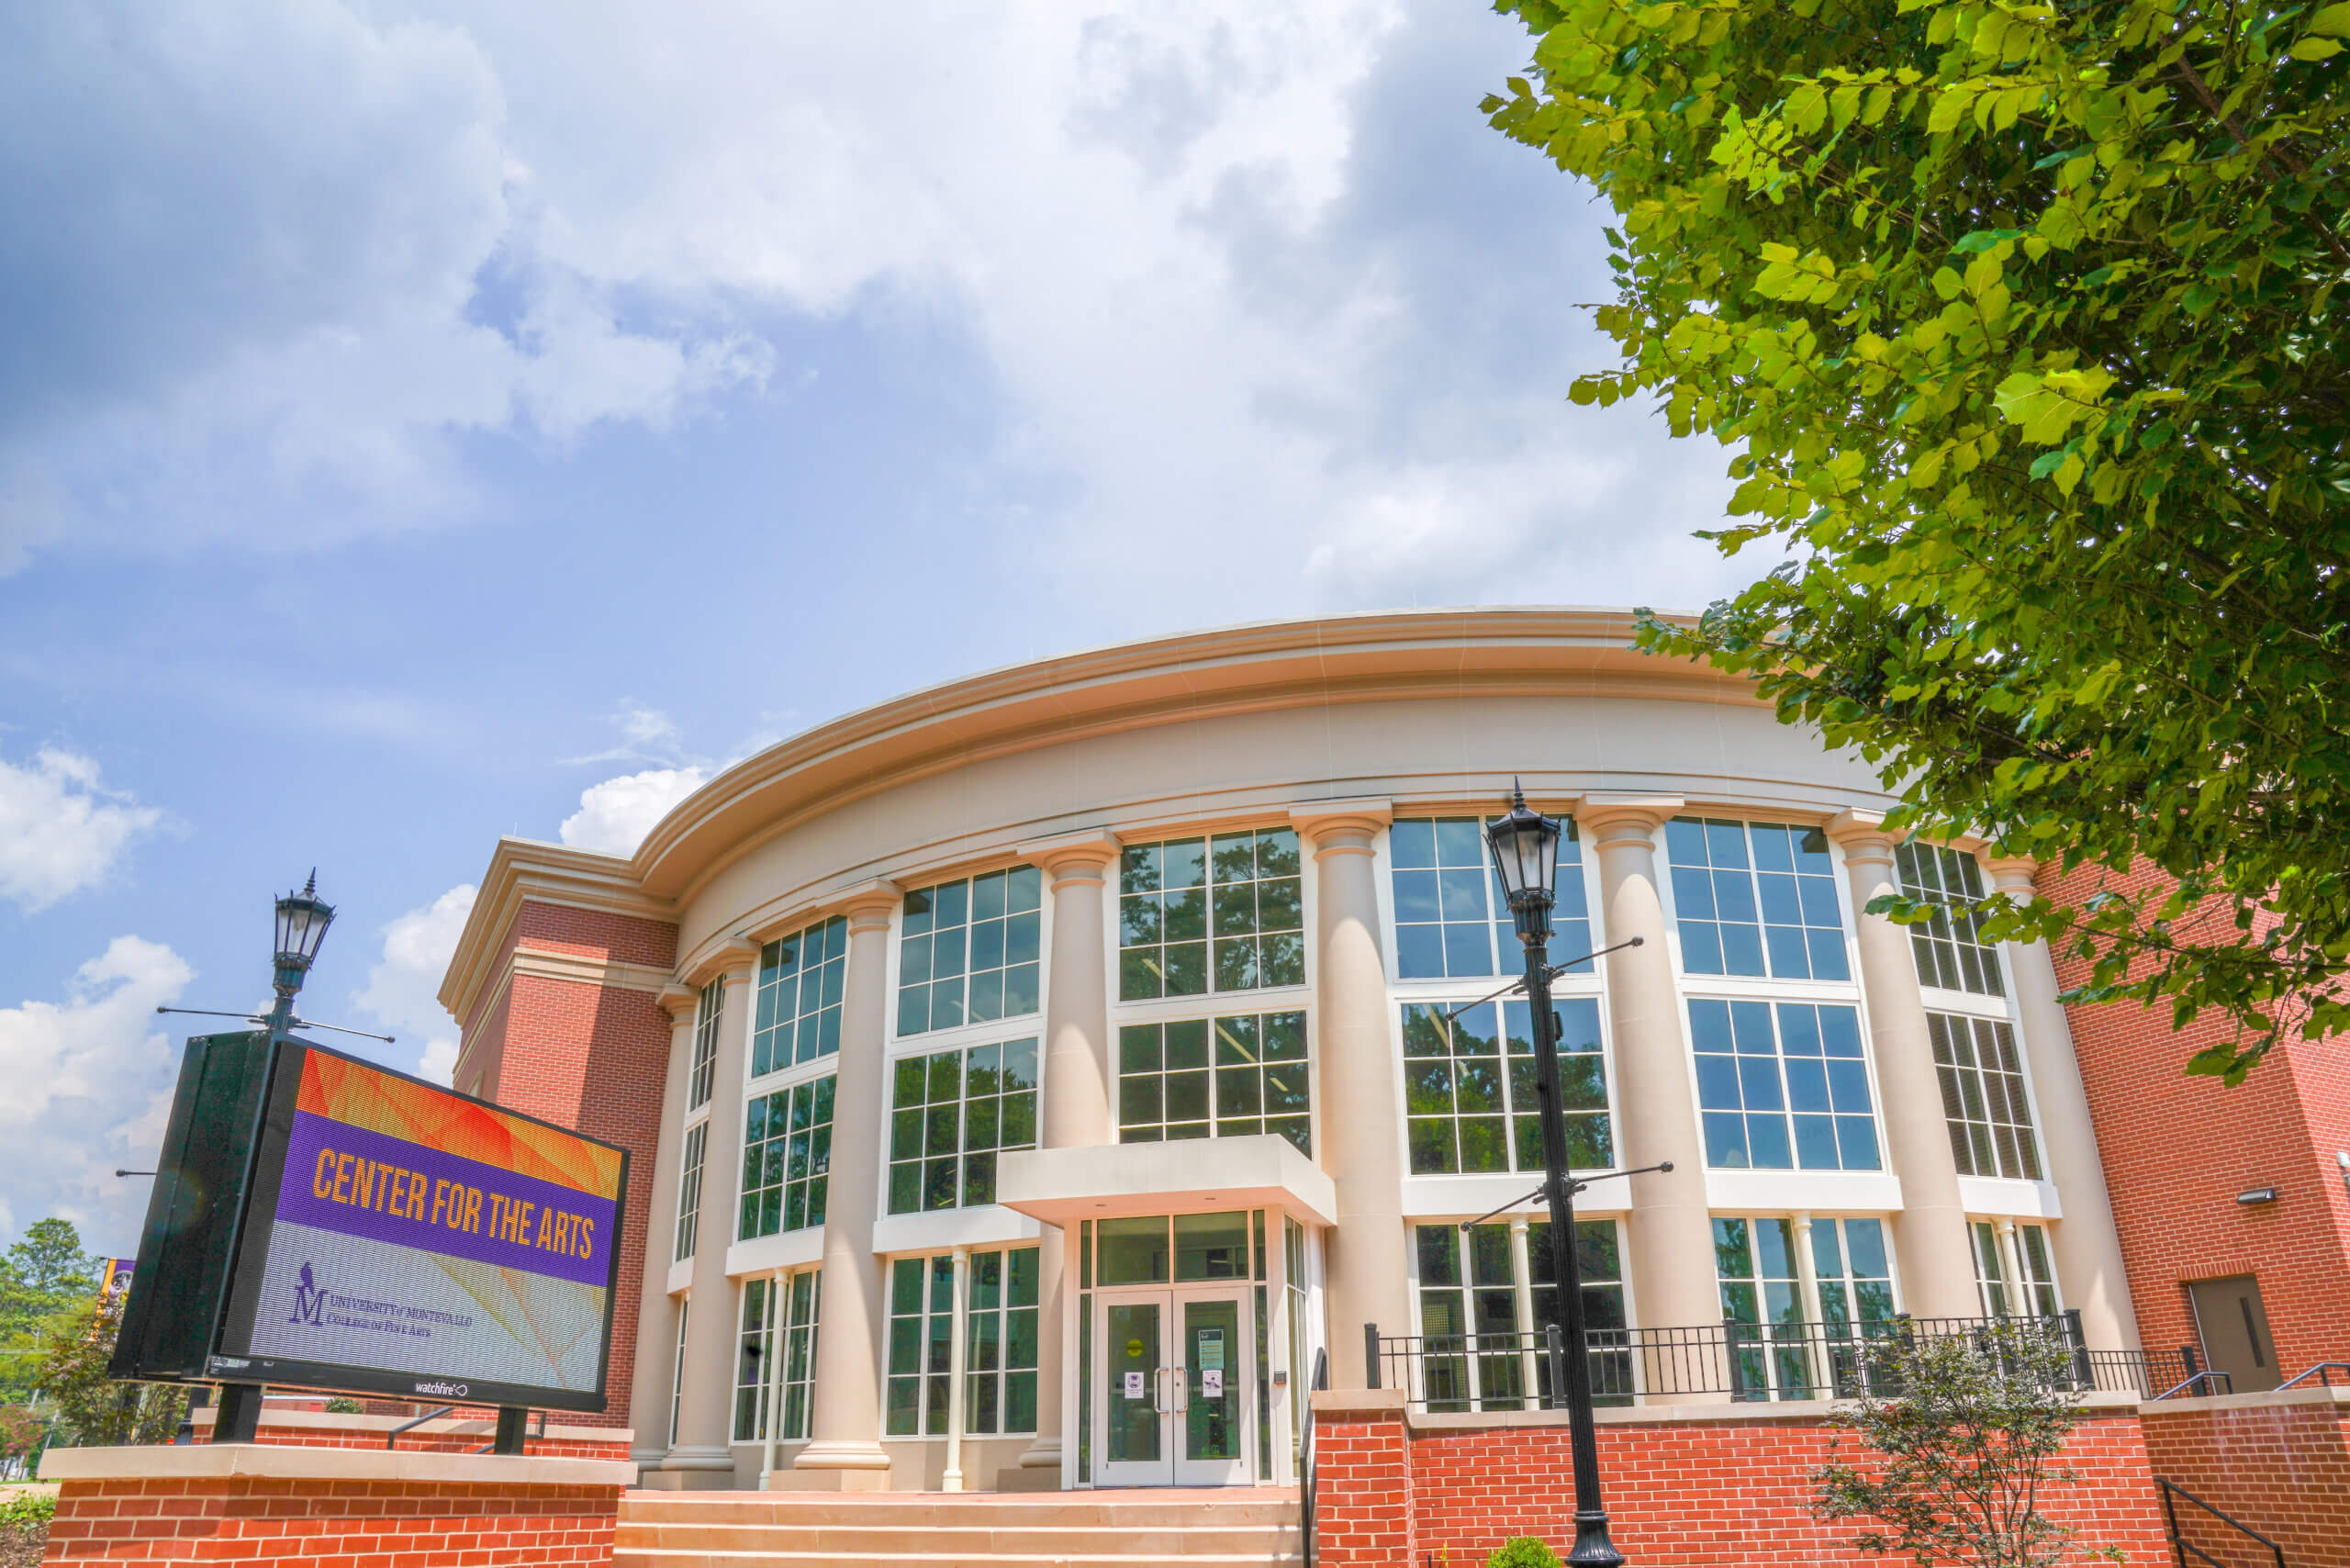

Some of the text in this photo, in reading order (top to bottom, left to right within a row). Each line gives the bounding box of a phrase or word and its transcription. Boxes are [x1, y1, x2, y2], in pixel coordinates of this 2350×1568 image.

[313, 1148, 595, 1260] CENTER FOR THE ARTS
[289, 1285, 329, 1327] M
[330, 1294, 397, 1316] UNIVERSITY
[407, 1306, 473, 1327] MONTEVALLO
[416, 1382, 453, 1395] watchfire
